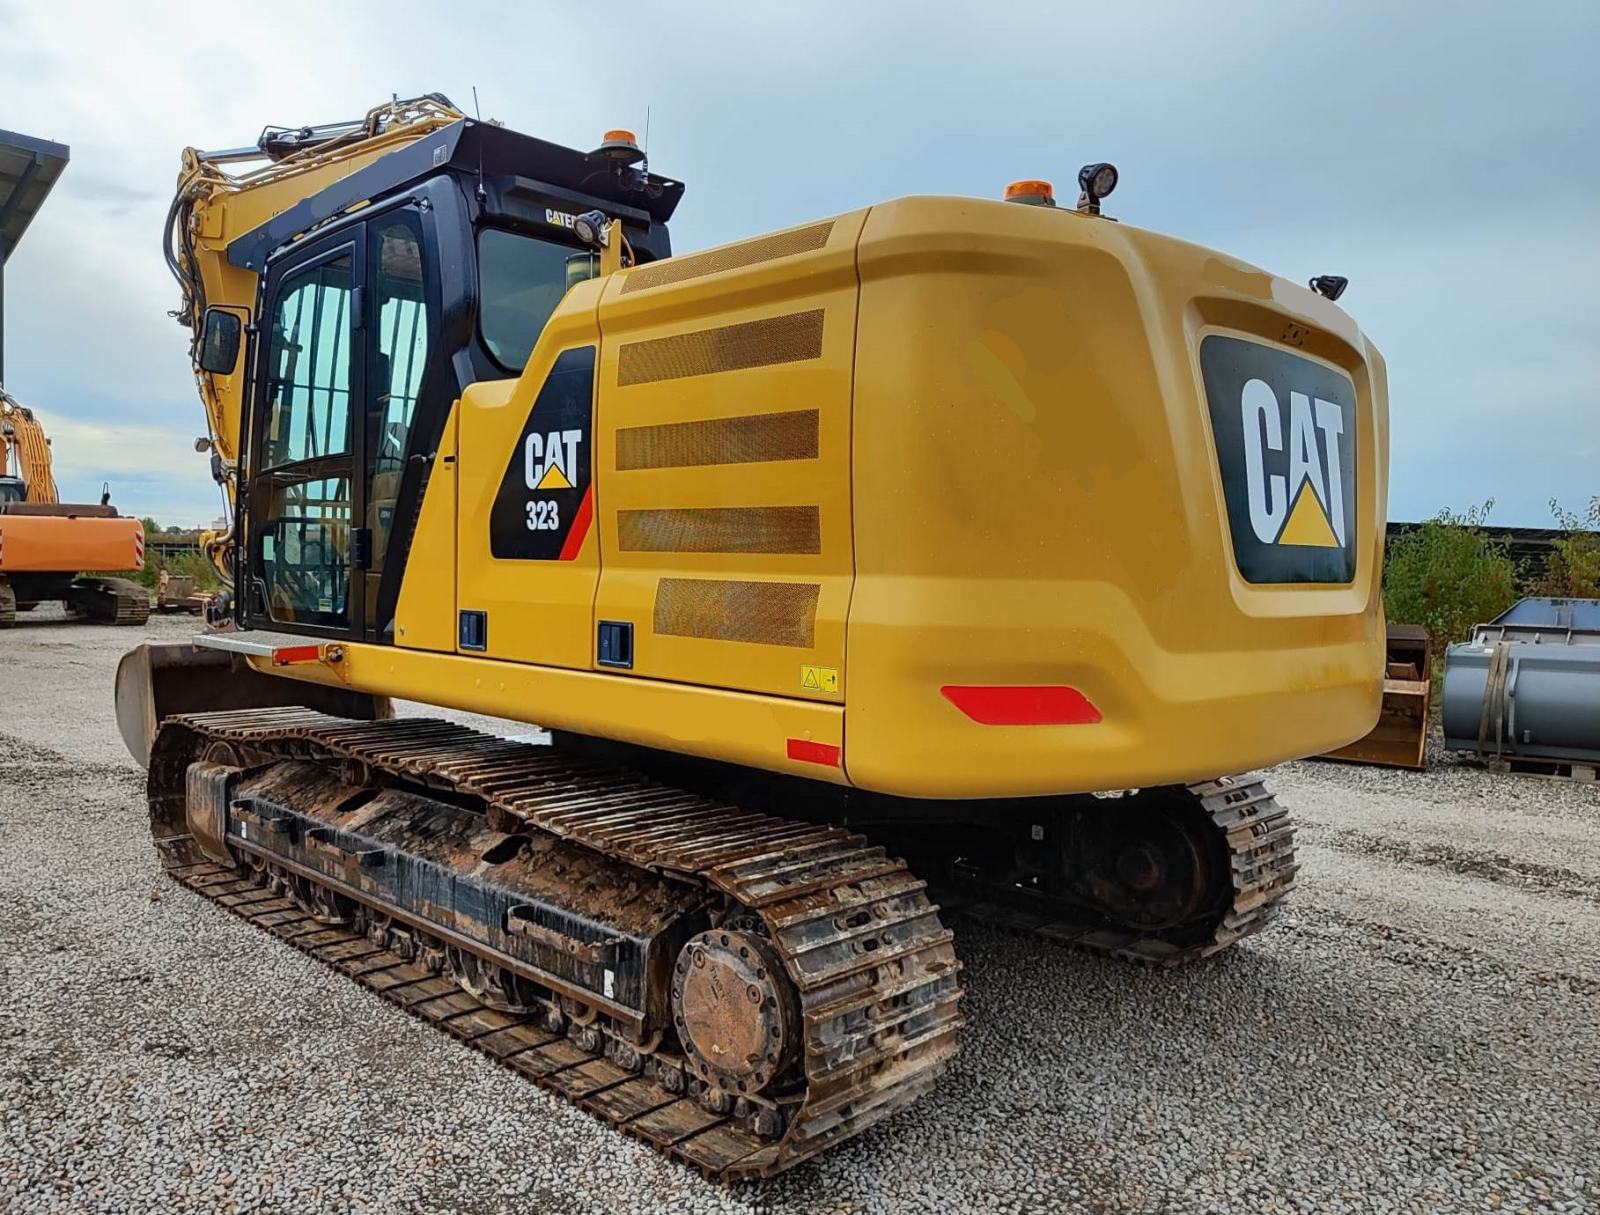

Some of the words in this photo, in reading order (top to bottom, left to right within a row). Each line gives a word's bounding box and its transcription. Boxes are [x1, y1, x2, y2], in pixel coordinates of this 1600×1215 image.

[525, 429, 582, 490] CAT
[1241, 378, 1346, 548] CAT
[526, 500, 559, 531] 323
